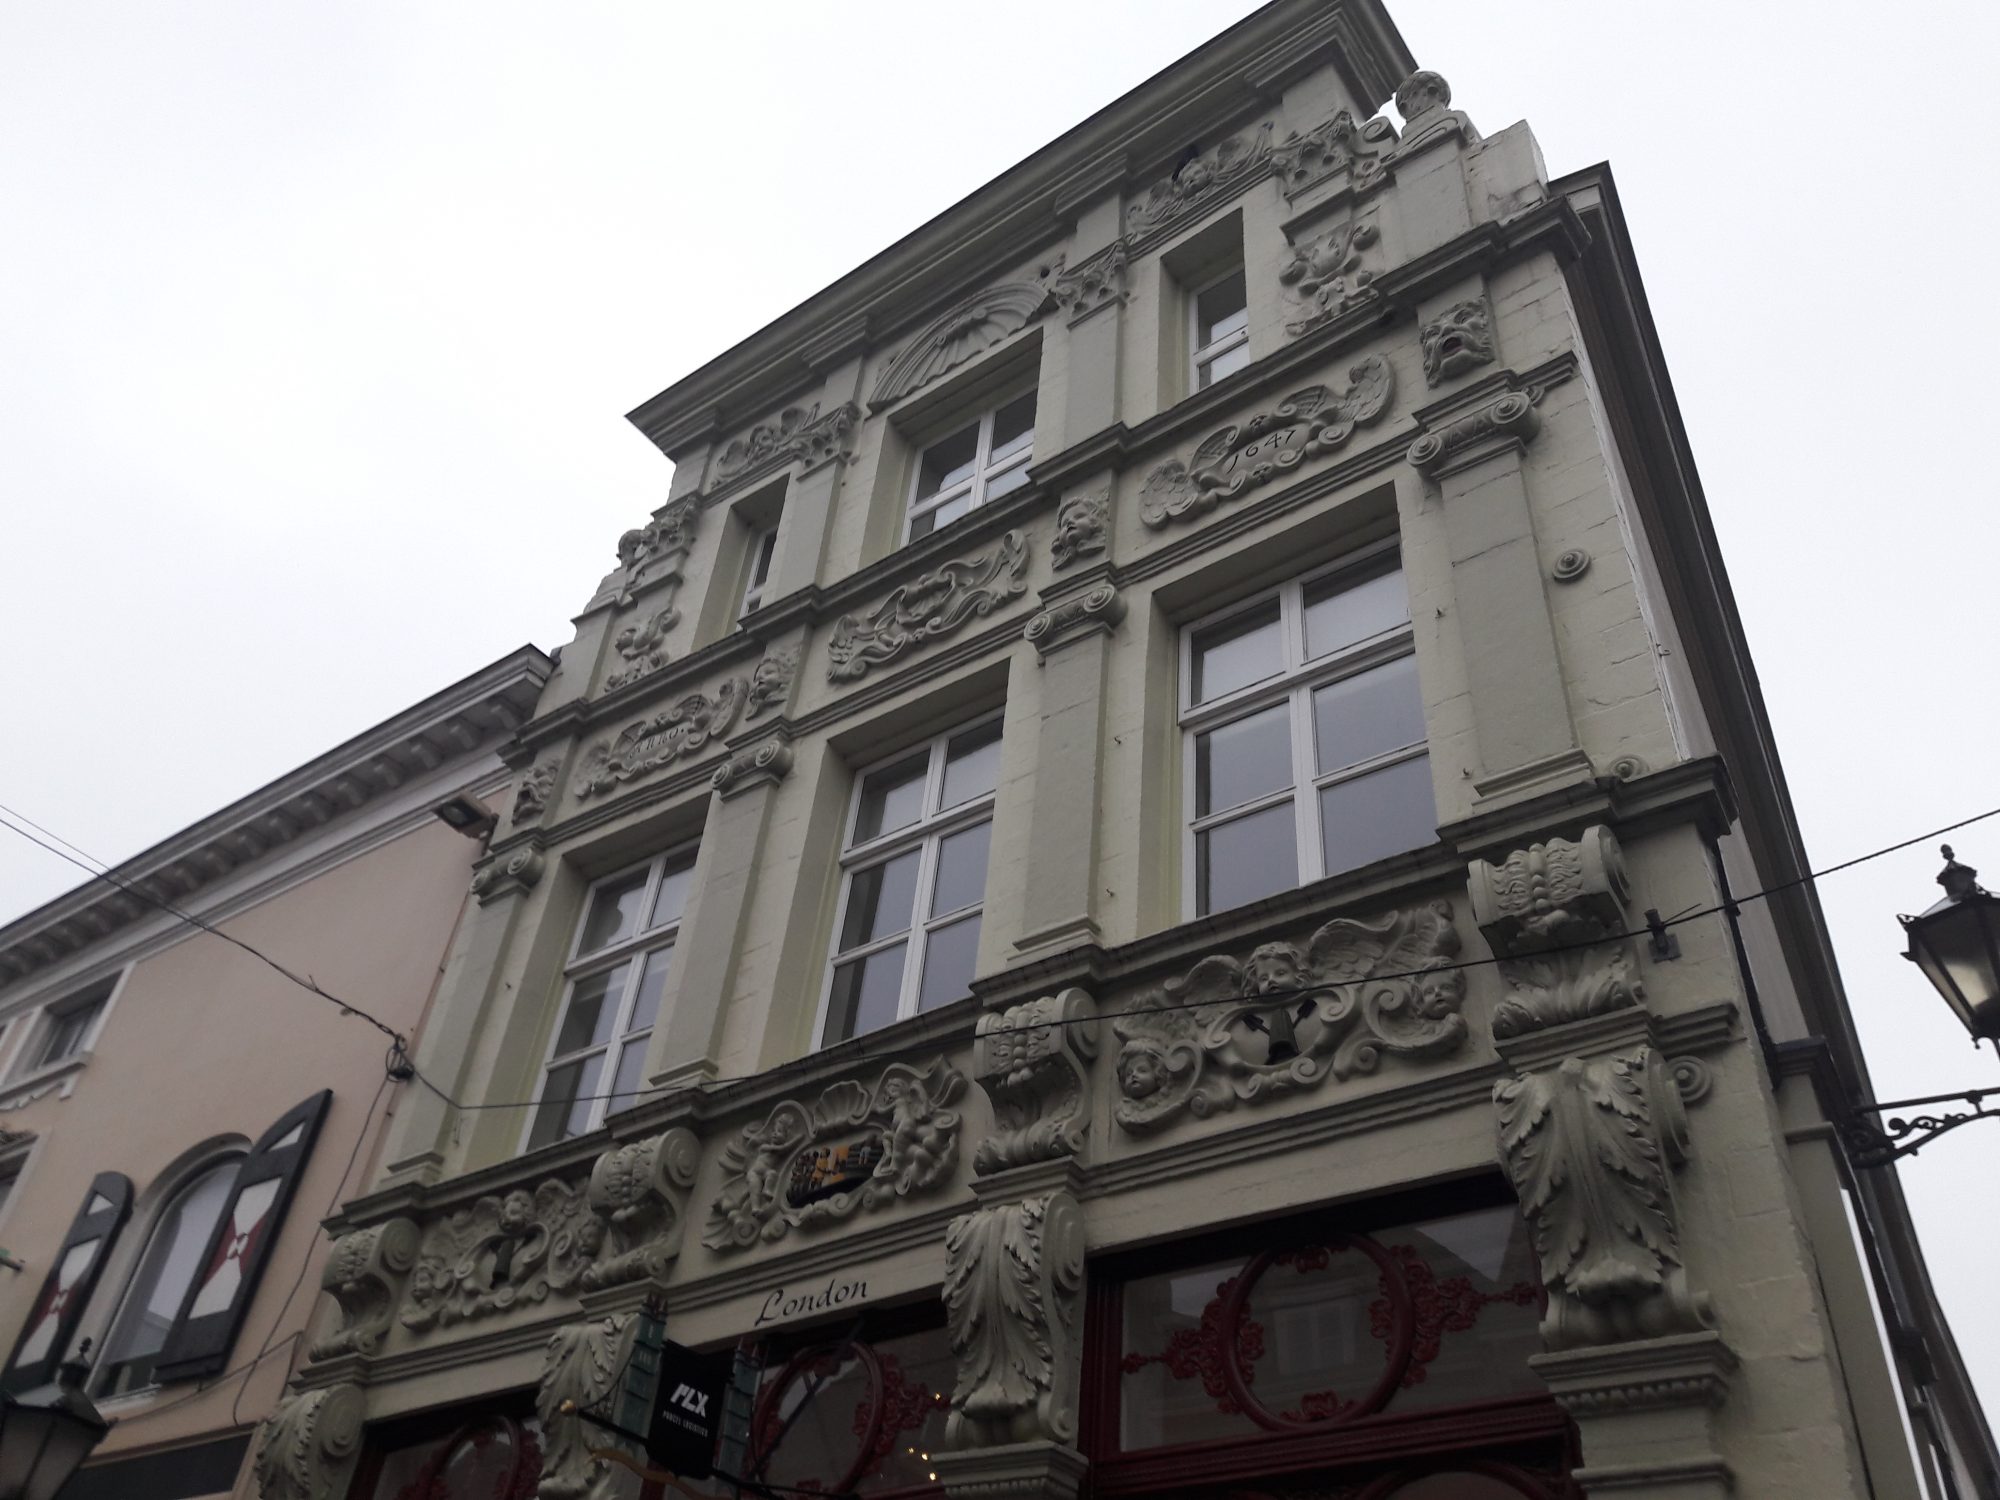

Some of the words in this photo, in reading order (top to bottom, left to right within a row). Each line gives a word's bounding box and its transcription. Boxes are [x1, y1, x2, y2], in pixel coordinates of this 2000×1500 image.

[1226, 429, 1297, 474] 1647
[754, 1279, 867, 1328] London
[670, 1383, 709, 1418] PLX
